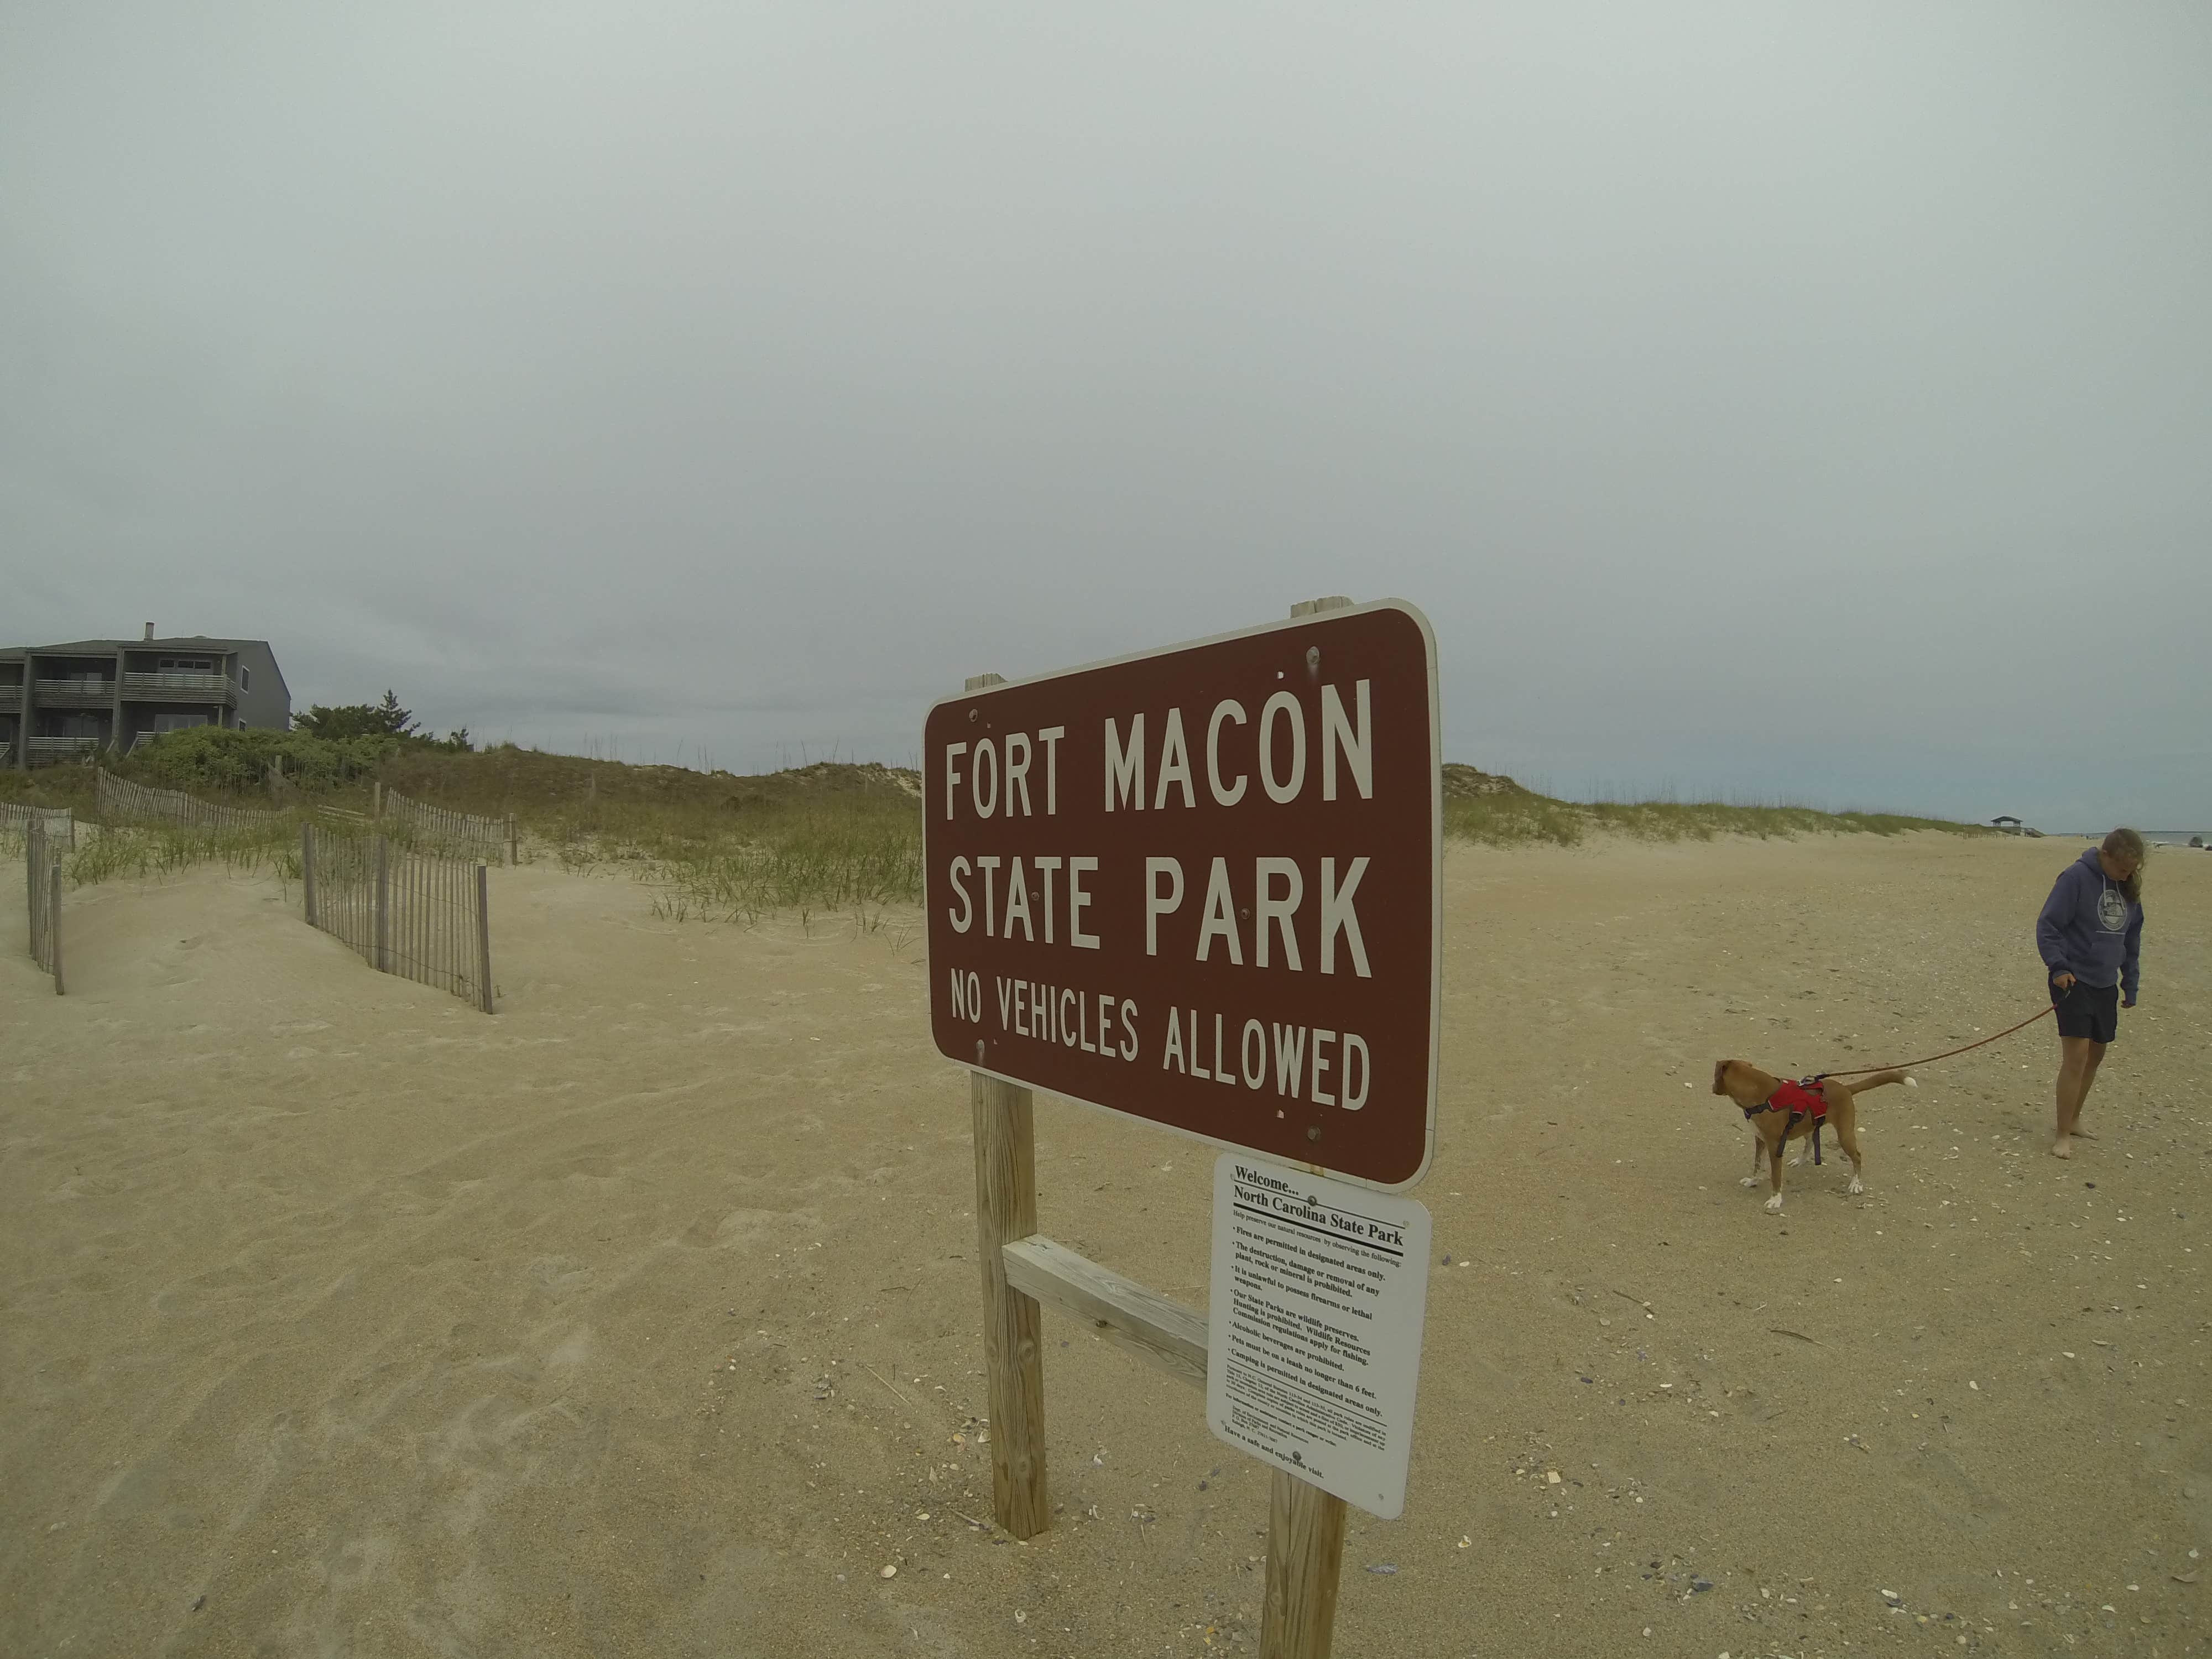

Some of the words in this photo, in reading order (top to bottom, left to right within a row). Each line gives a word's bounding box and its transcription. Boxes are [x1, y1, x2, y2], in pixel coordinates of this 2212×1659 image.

[947, 726, 1064, 820] FORT
[1105, 679, 1372, 811] MACON
[950, 856, 1099, 949] STATE
[1146, 857, 1371, 978] PARK
[951, 968, 980, 1022] NO
[997, 977, 1138, 1061] VEHICLES
[1164, 1006, 1369, 1110] ALLOWED
[1235, 1165, 1298, 1195] Welcome...
[1233, 1209, 1245, 1219] Help
[1245, 1215, 1266, 1225] preserve
[1277, 1225, 1295, 1234] natural
[1296, 1231, 1321, 1243] resources
[1324, 1238, 1331, 1246] by
[1332, 1241, 1359, 1256] observing
[1371, 1252, 1401, 1267] following:
[1234, 1185, 1269, 1207] North
[1272, 1197, 1326, 1224] Carolina
[1330, 1213, 1364, 1234] State
[1367, 1223, 1403, 1246] Park
[1235, 1240, 1248, 1251] The
[1249, 1246, 1287, 1266] destruction,
[1288, 1259, 1315, 1275] damage
[1326, 1274, 1355, 1287] removal
[1365, 1286, 1379, 1296] any
[1235, 1251, 1253, 1264] plant,
[1255, 1259, 1269, 1269] rock
[1280, 1267, 1305, 1281] mineral
[1307, 1275, 1312, 1284] is
[1313, 1279, 1352, 1297] prohibited.
[1237, 1225, 1252, 1238] Fires
[1265, 1237, 1297, 1253] permitted
[1299, 1246, 1306, 1255] in
[1307, 1250, 1344, 1267] designated
[1345, 1264, 1366, 1274] areas
[1367, 1270, 1385, 1281] only.
[1234, 1276, 1262, 1291] weapons.
[1235, 1265, 1240, 1273] It
[1241, 1267, 1246, 1275] is
[1248, 1271, 1276, 1286] unlawful
[1285, 1285, 1309, 1298] possess
[1311, 1292, 1340, 1308] firearms
[1351, 1306, 1372, 1320] lethal
[1233, 1288, 1246, 1299] Our
[1248, 1294, 1264, 1306] State
[1265, 1300, 1284, 1314] Parks
[1285, 1310, 1296, 1318] are
[1298, 1314, 1322, 1328] wildlife
[1324, 1324, 1359, 1342] preserves.
[1233, 1297, 1259, 1315] Hunting
[1260, 1307, 1265, 1316] is
[1266, 1312, 1302, 1331] prohibited.
[1306, 1325, 1333, 1342] Wildlife
[1334, 1336, 1370, 1355] Resources
[1233, 1307, 1270, 1327] Commission
[1272, 1324, 1308, 1342] regulations
[1310, 1338, 1328, 1351] apply
[1330, 1345, 1341, 1354] for
[1342, 1349, 1368, 1366] fishing.
[1232, 1321, 1260, 1338] Alcoholic
[1262, 1332, 1293, 1351] beverages
[1295, 1348, 1306, 1356] are
[1307, 1352, 1344, 1371] prohibited.
[1232, 1334, 1244, 1345] Pets
[1245, 1342, 1261, 1352] must
[1262, 1347, 1270, 1356] be
[1286, 1357, 1302, 1370] leash
[1314, 1368, 1336, 1383] longer
[1337, 1379, 1353, 1390] than
[1361, 1387, 1376, 1399] feet.
[1231, 1348, 1259, 1366] Camping
[1260, 1360, 1265, 1368] is
[1266, 1365, 1298, 1382] permitted
[1299, 1376, 1306, 1385] in
[1307, 1380, 1343, 1401] designated
[1344, 1397, 1363, 1409] areas
[1365, 1406, 1382, 1417] only.
[1224, 1425, 1240, 1438] Have
[1247, 1438, 1260, 1447] safe
[1261, 1444, 1273, 1454] and
[1275, 1451, 1306, 1469] enjoyable
[1308, 1467, 1323, 1478] visit.
